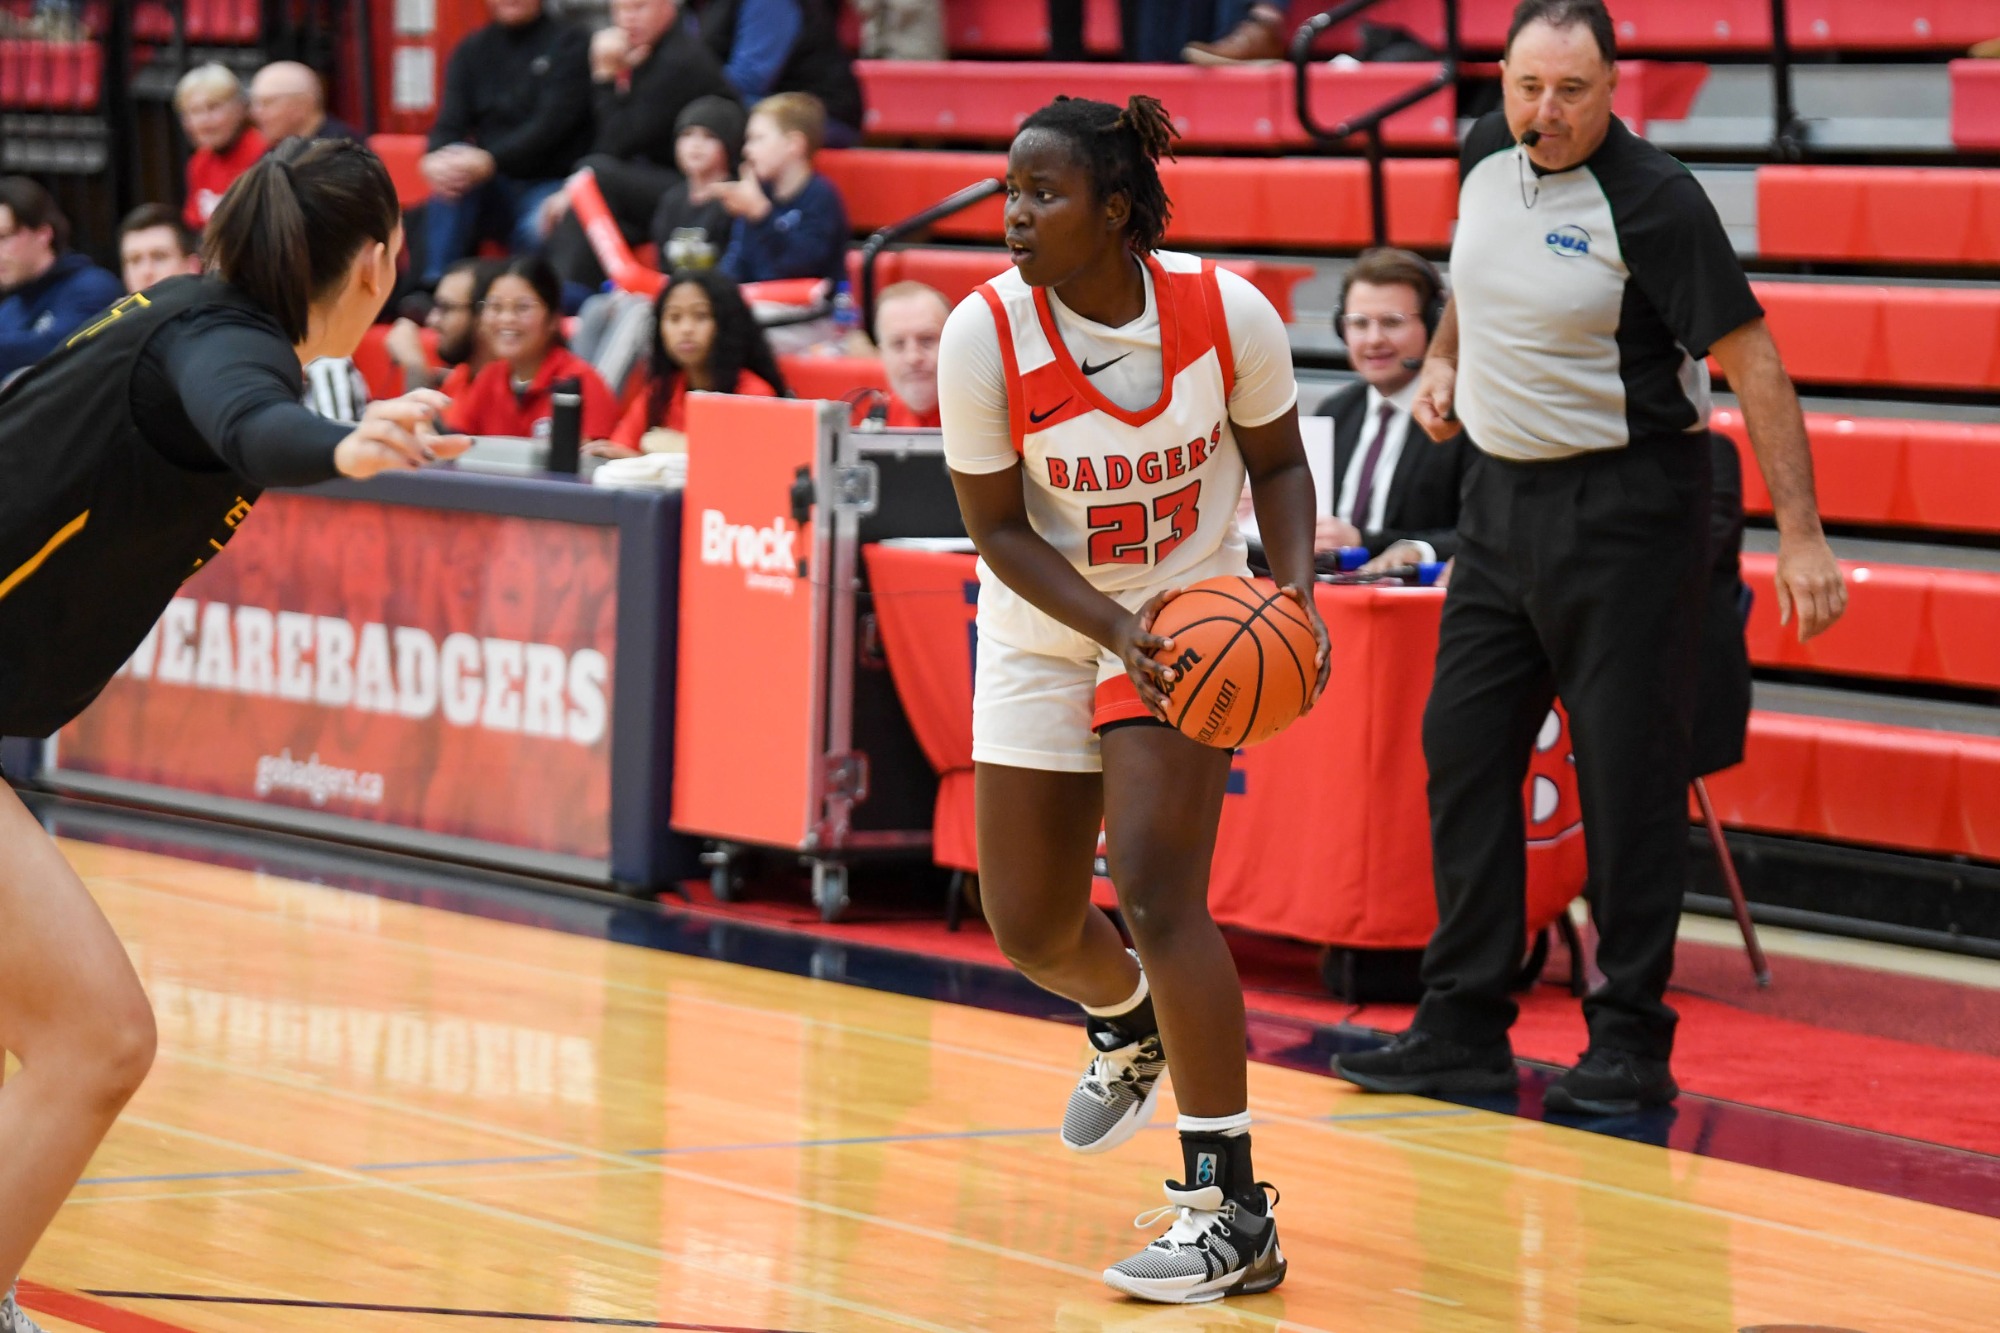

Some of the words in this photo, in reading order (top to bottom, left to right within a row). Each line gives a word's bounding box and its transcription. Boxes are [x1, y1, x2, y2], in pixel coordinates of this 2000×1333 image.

[1545, 233, 1590, 255] OUA
[1045, 420, 1221, 492] BADGERS
[701, 508, 797, 572] Brock
[1087, 478, 1202, 567] 23
[254, 746, 385, 806] gobadgers.ca
